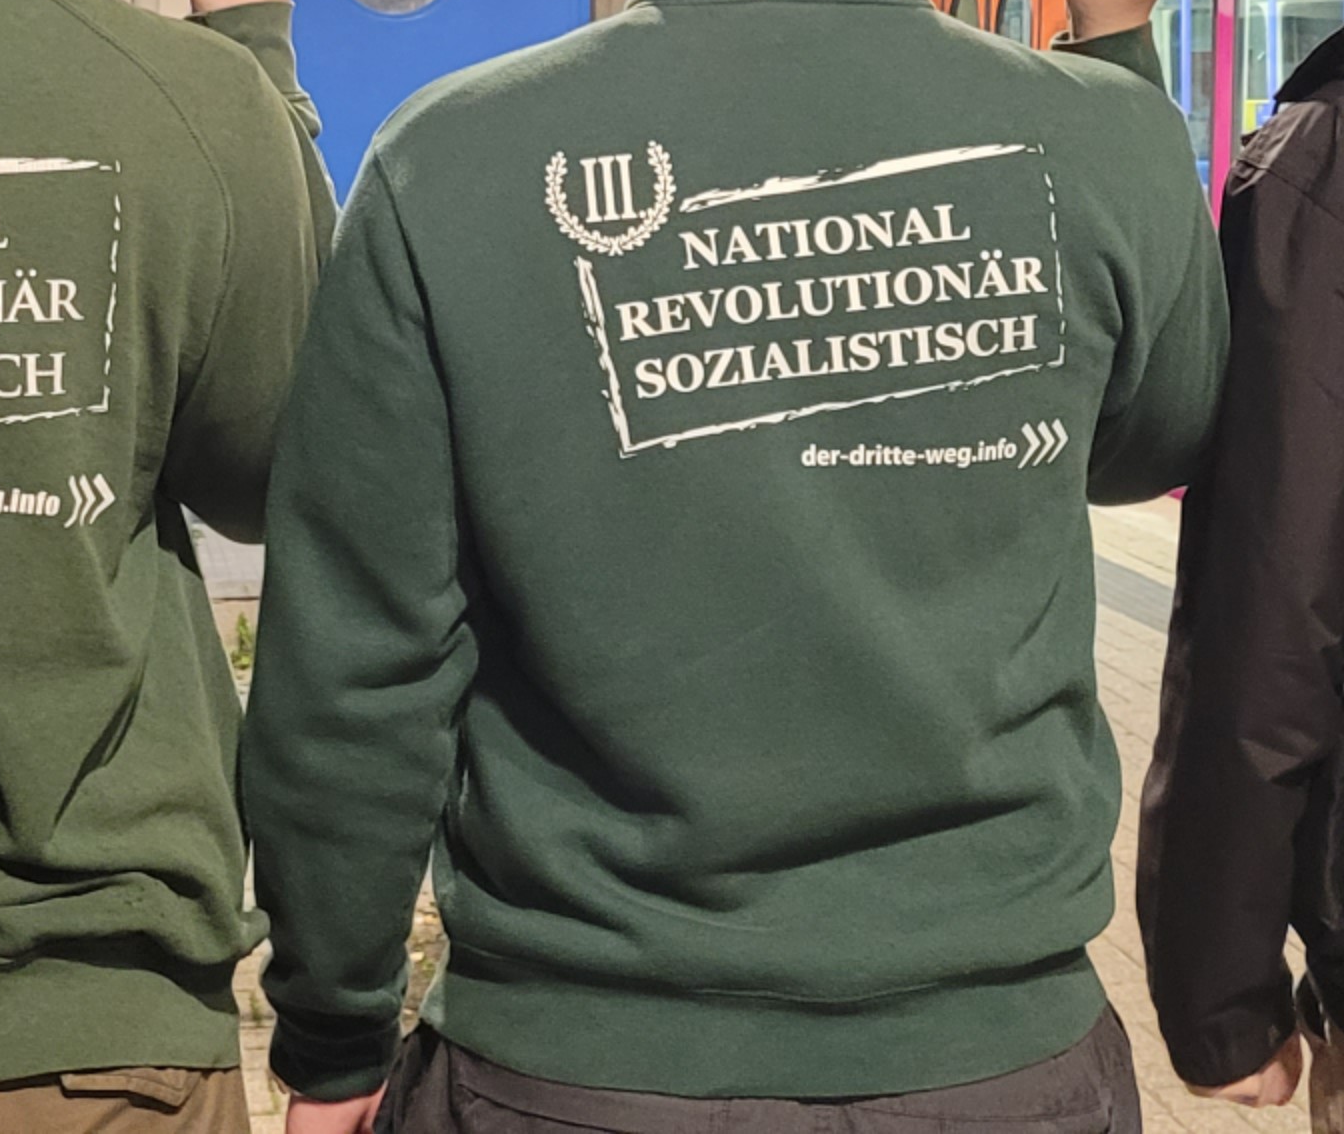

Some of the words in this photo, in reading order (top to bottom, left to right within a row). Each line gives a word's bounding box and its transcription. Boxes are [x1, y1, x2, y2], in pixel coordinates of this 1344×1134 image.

[678, 203, 971, 270] NATIONAL
[614, 248, 1049, 341] REVOLUTIONÄR
[634, 314, 1038, 399] SOZIALISTISCH
[800, 438, 1017, 469] der-dritte-weg.info
